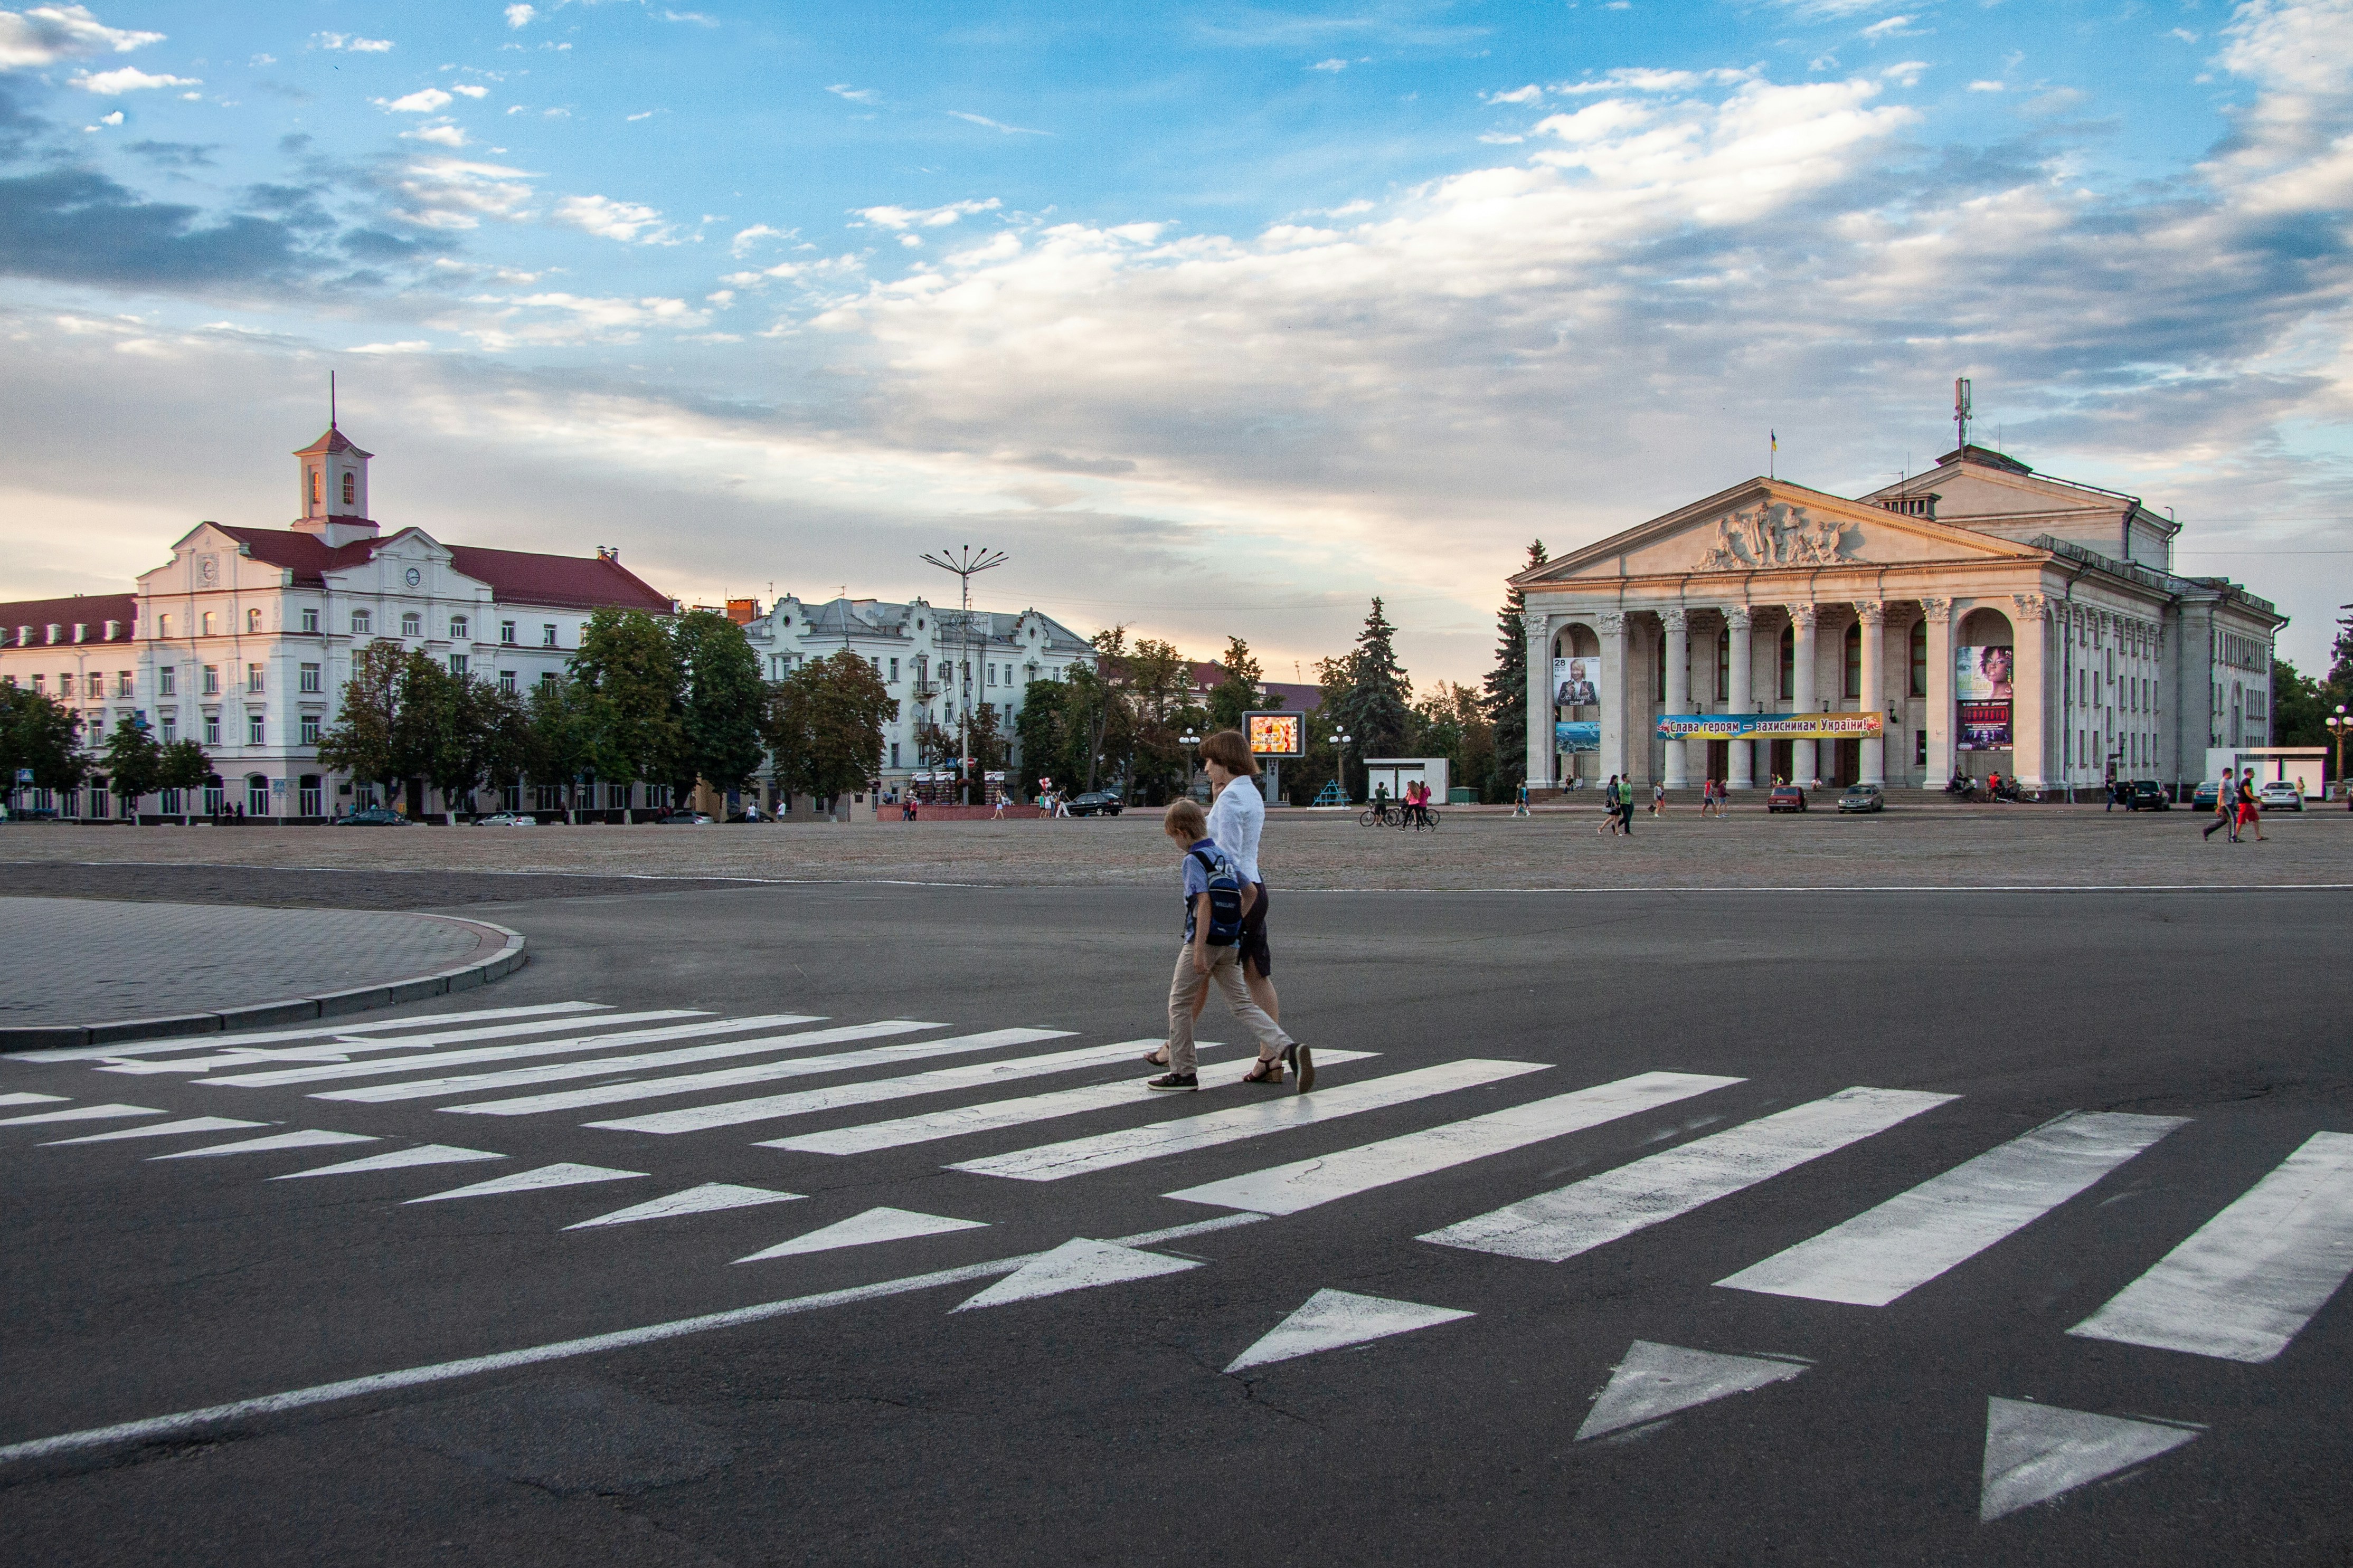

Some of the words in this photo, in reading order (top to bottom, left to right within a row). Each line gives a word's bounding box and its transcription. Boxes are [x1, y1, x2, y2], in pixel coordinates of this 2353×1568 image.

[1670, 721, 1699, 733] Слава
[1703, 721, 1740, 734] героям
[1756, 721, 1816, 731] захисникам
[1820, 718, 1867, 733] України!
